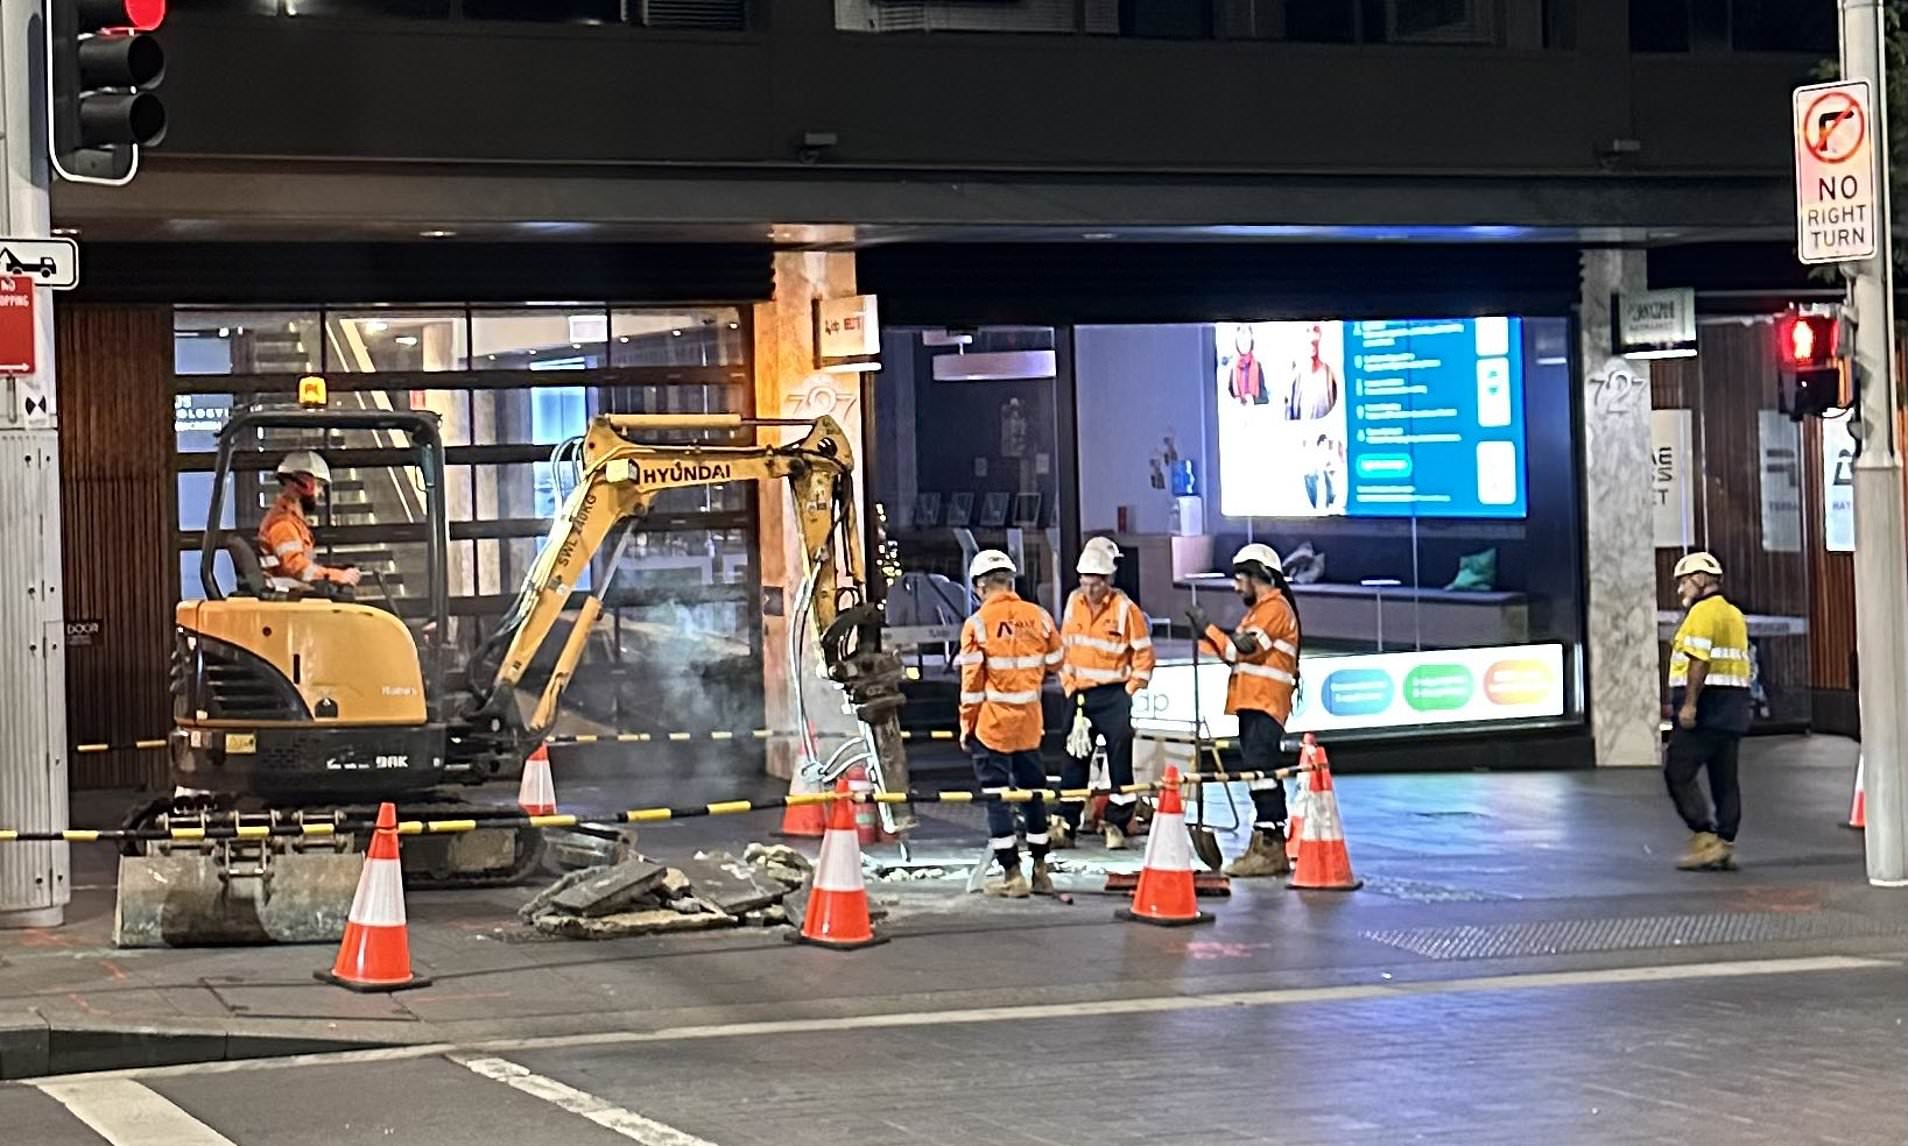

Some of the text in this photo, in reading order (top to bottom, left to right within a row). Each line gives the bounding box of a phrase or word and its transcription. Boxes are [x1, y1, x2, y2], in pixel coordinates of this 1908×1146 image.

[1819, 174, 1858, 202] NO
[1808, 204, 1867, 226] RIGHT
[1811, 227, 1865, 250] TURN
[1588, 369, 1649, 415] 727
[643, 463, 731, 484] HYUNDAI
[557, 538, 579, 567] SWL
